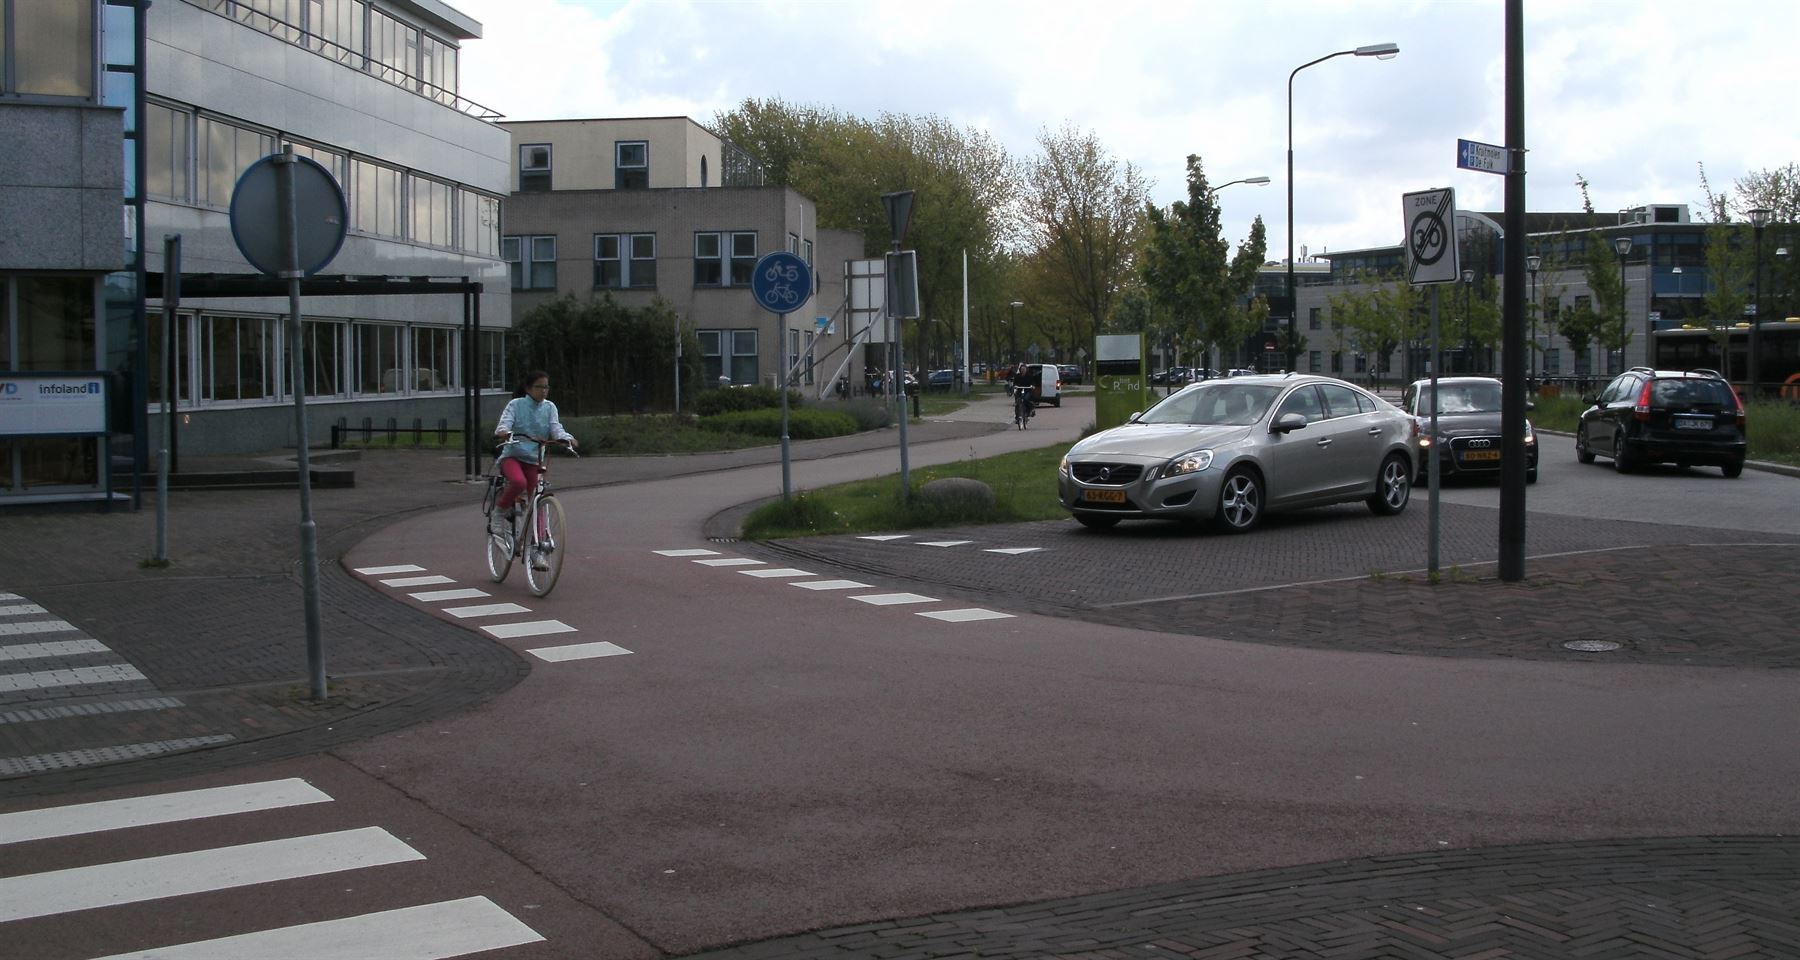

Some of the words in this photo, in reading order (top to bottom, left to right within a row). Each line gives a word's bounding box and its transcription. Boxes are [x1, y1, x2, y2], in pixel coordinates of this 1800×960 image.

[1415, 195, 1437, 206] ZONE
[1415, 228, 1440, 250] 30
[40, 384, 87, 394] infoland
[1113, 379, 1140, 391] Rnd
